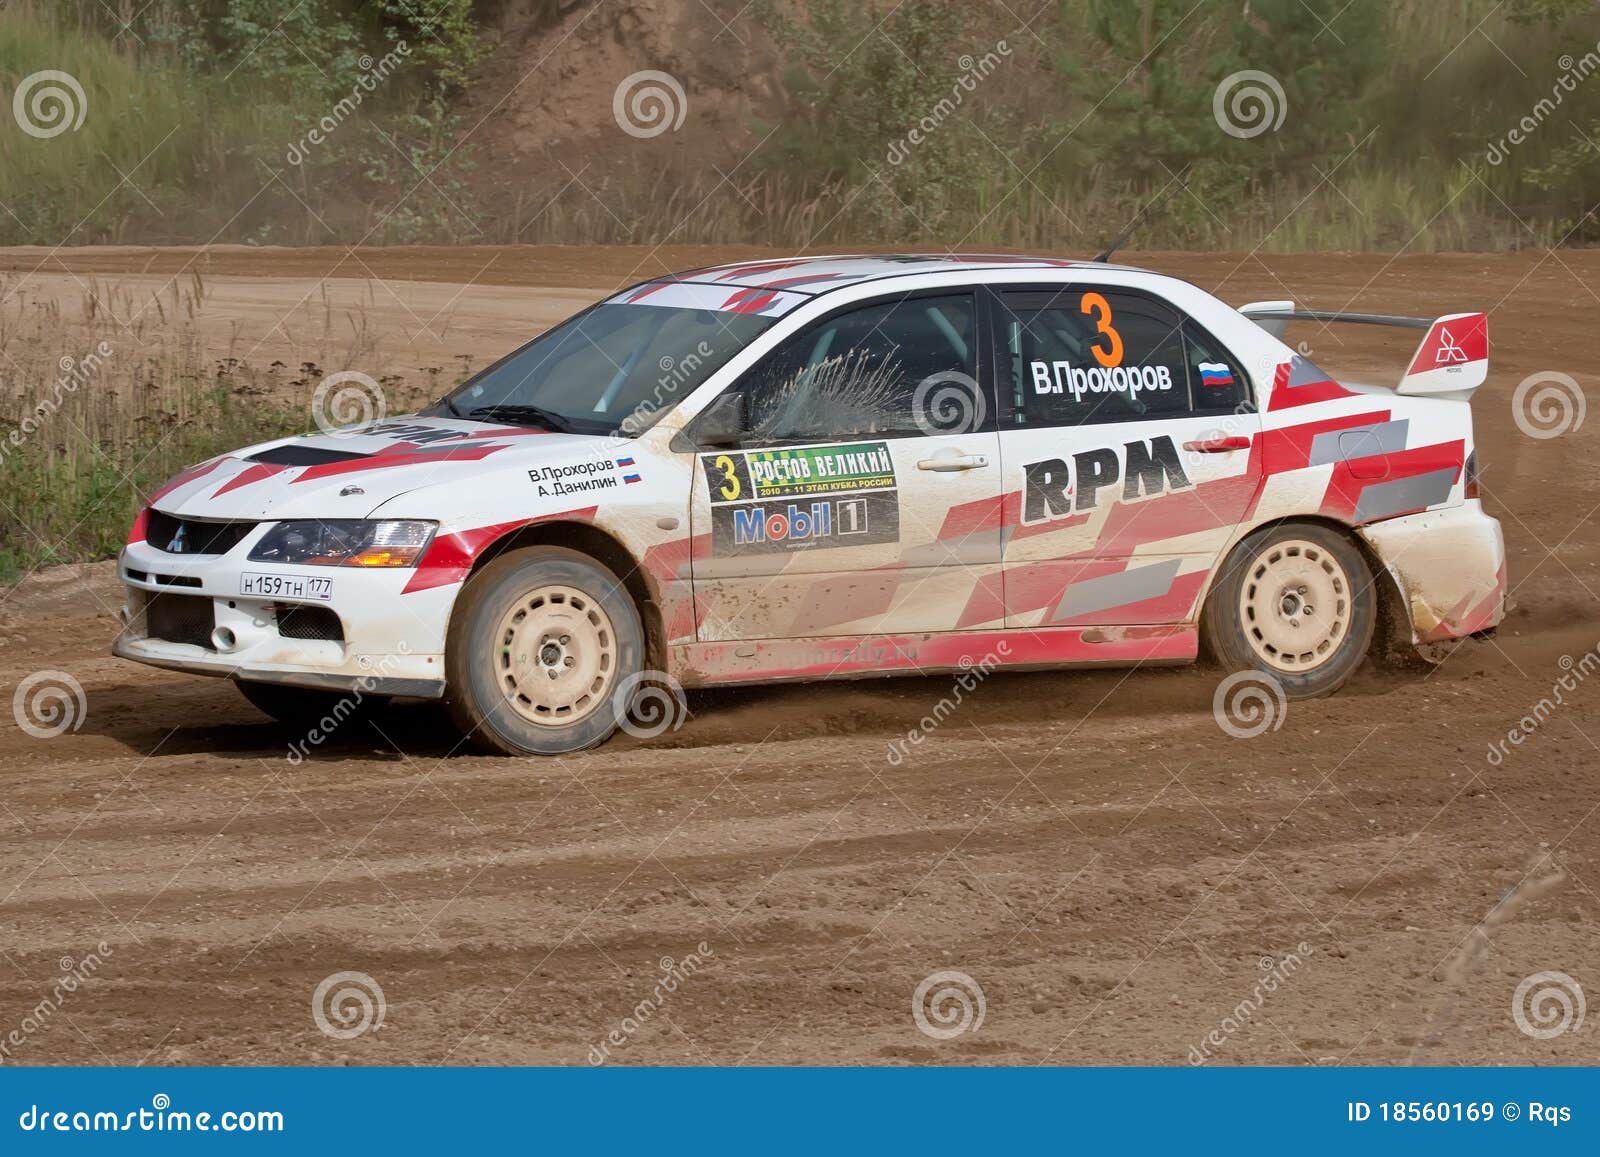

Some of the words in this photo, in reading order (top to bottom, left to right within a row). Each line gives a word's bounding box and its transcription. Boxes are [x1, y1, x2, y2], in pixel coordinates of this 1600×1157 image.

[1080, 292, 1124, 368] 3
[1030, 361, 1173, 402] В.Прохоров
[528, 460, 615, 482] В.Прохоров
[715, 455, 741, 501] 3
[754, 457, 812, 483] РОСТОВ
[815, 446, 892, 477] ВЕЛИКИЙ
[1022, 434, 1193, 523] RPM
[538, 477, 618, 497] А.Данилин
[760, 487, 781, 496] 2010
[806, 484, 829, 493] ЭТАП
[830, 481, 857, 491] КУБКА
[859, 478, 893, 488] РОССИИ
[733, 501, 832, 545] Mobil
[309, 579, 331, 593] 177
